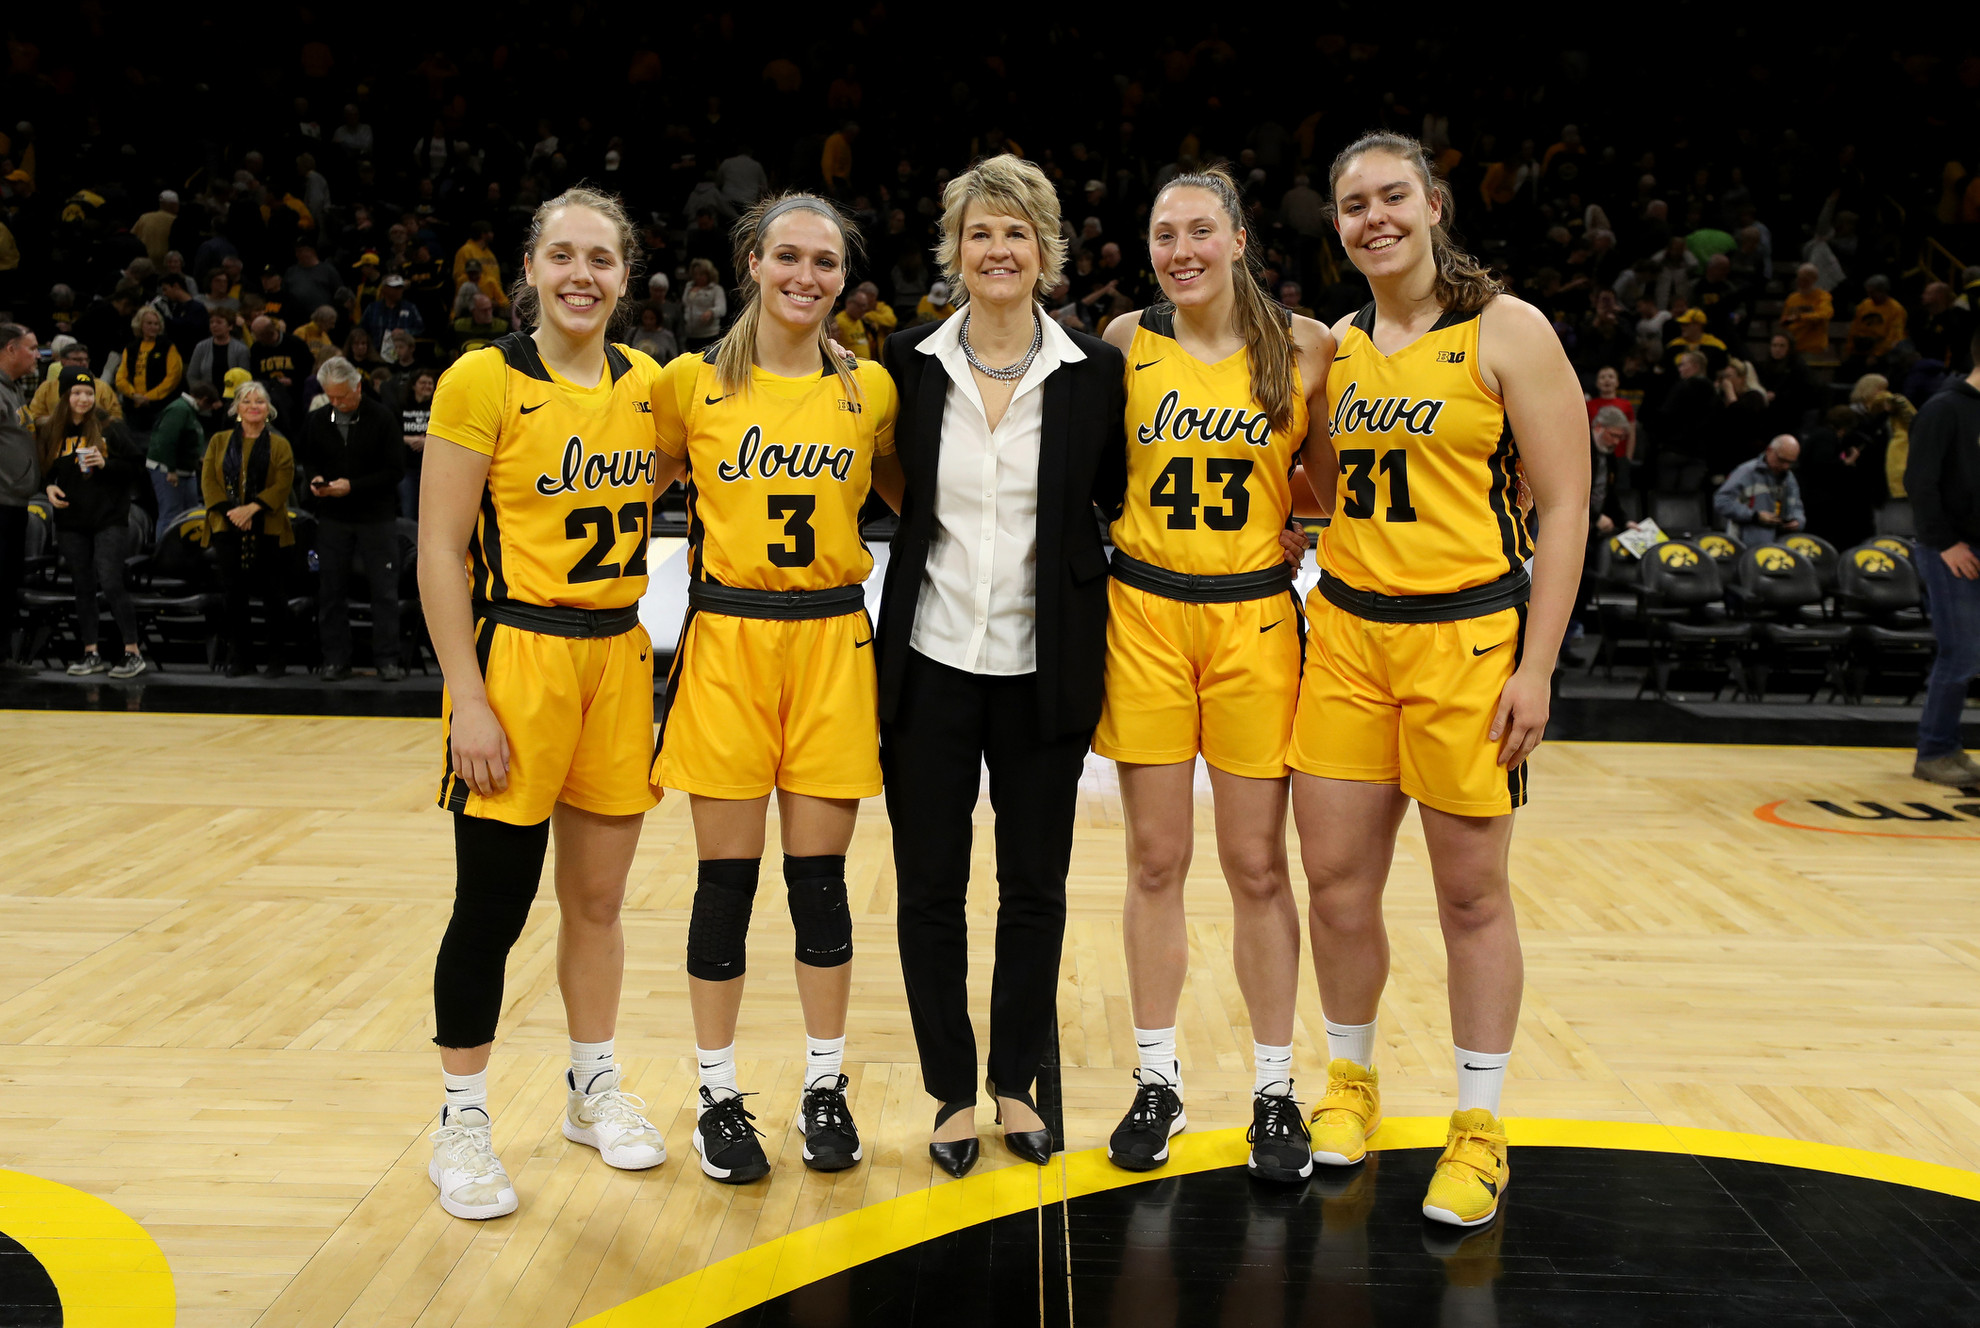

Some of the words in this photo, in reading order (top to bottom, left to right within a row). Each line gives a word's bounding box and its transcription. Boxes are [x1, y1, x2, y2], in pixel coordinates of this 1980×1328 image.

[1137, 388, 1272, 447] Iowa
[1329, 381, 1446, 440] Iowa
[535, 434, 657, 497] Iowa
[717, 424, 856, 483] Iowa
[1339, 449, 1418, 522] 31
[1150, 457, 1254, 531] 43
[564, 501, 649, 585] 22
[767, 494, 815, 568] 3
